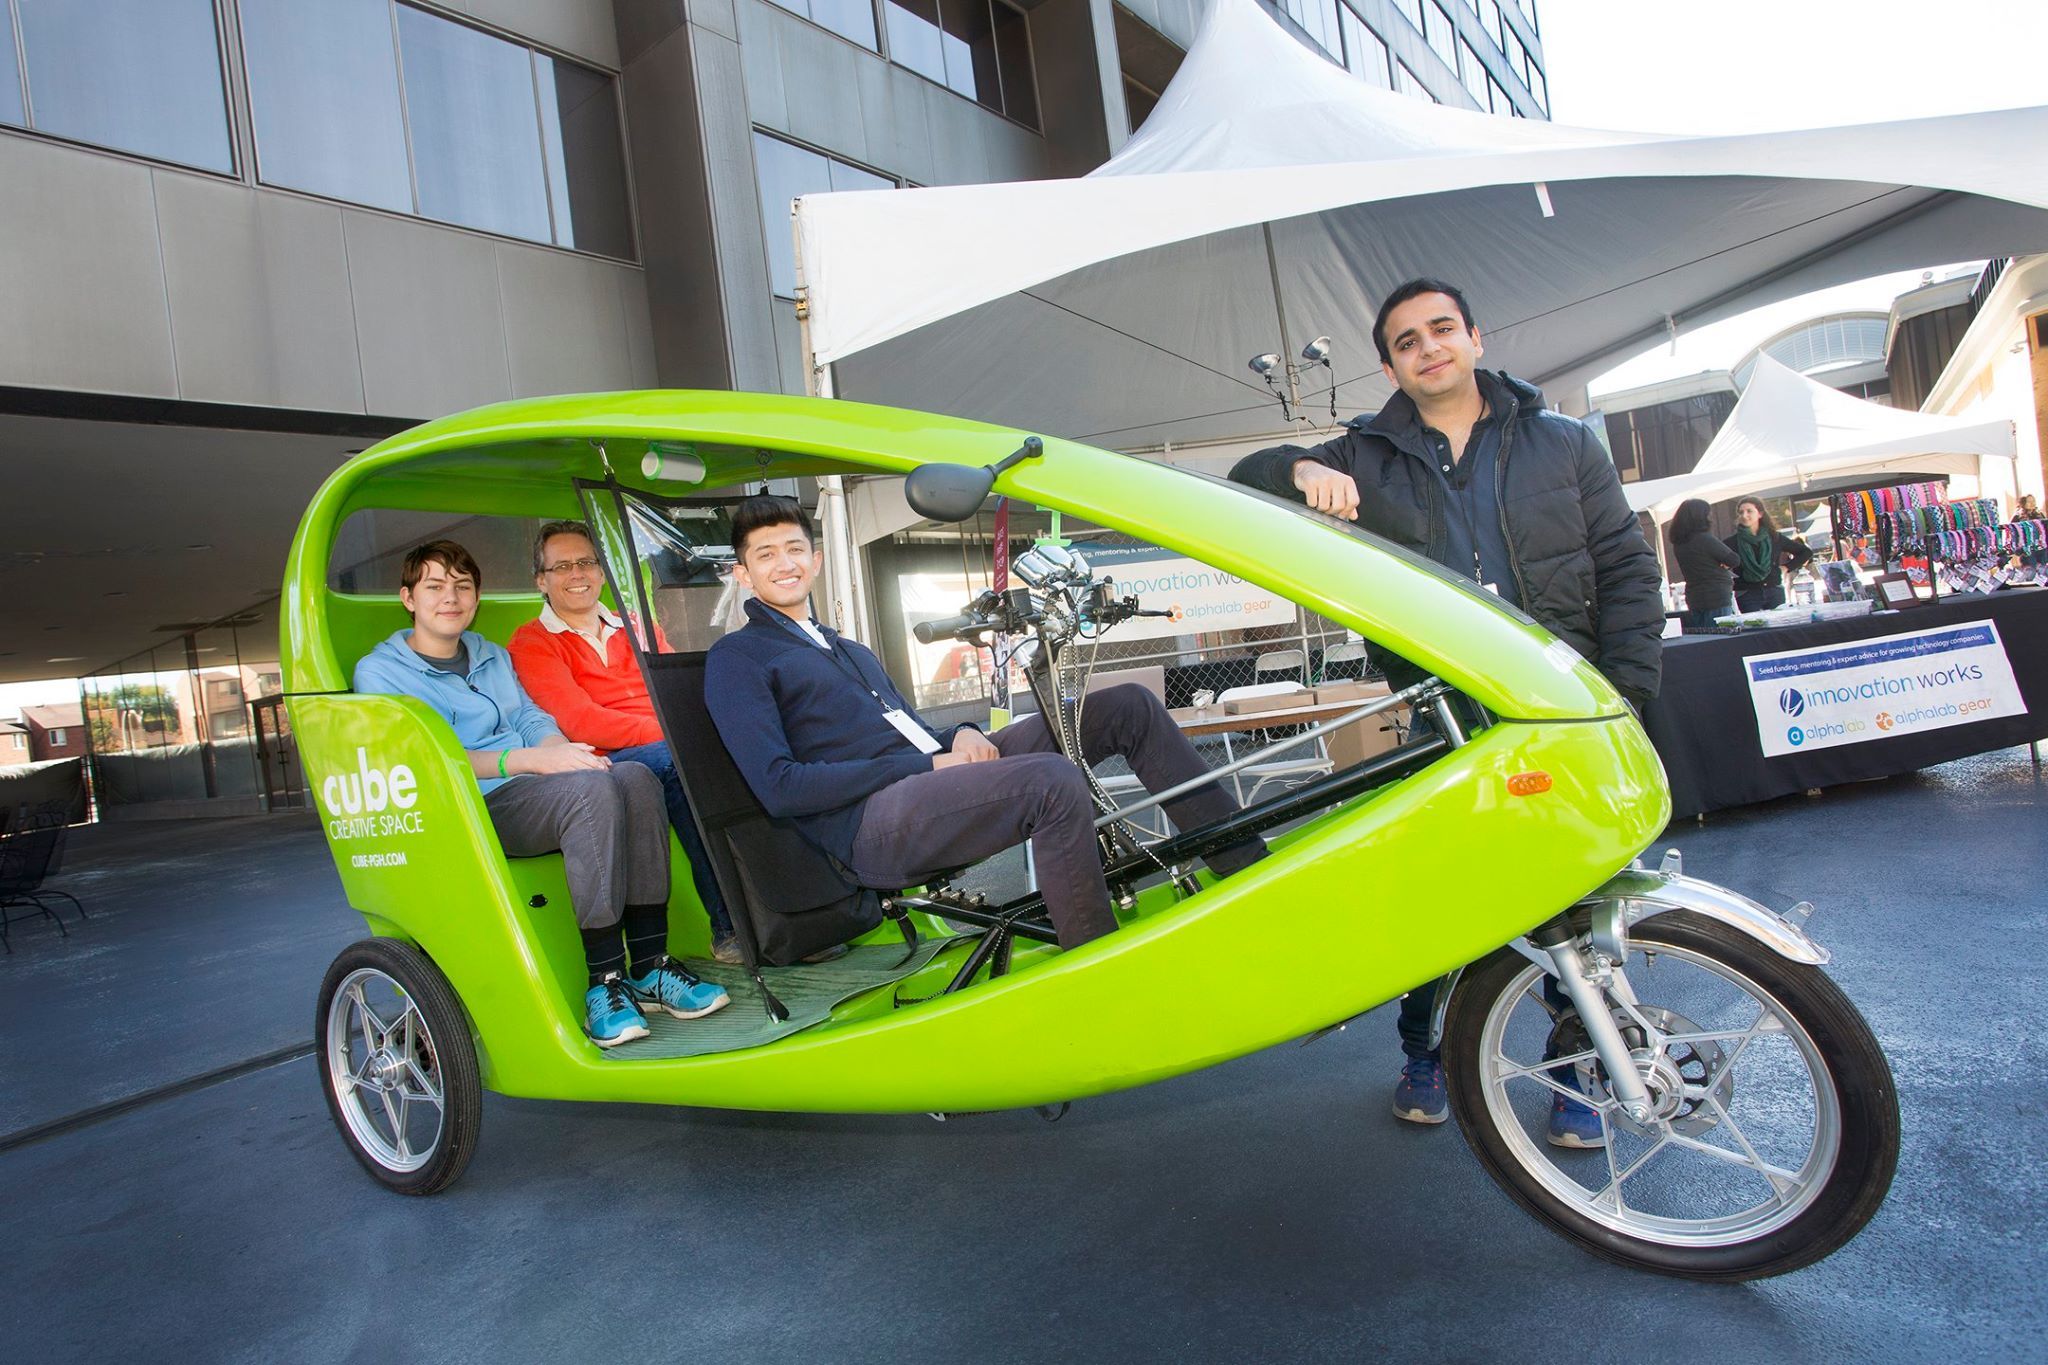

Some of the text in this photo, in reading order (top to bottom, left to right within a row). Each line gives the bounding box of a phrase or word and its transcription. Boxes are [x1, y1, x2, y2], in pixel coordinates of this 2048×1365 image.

[1095, 548, 1130, 557] mentoring
[1185, 599, 1272, 618] alphalab gear
[1759, 667, 1774, 675] Seed
[1774, 664, 1799, 673] funding,
[1800, 659, 1832, 669] mentoring
[1837, 654, 1858, 665] expert
[1858, 651, 1879, 660] advice
[1879, 649, 1888, 657] for
[1889, 645, 1916, 656] growing
[1916, 639, 1950, 651] technology
[1950, 633, 1984, 645] companies
[1806, 663, 1983, 707] innovation works
[1806, 717, 1865, 739] alphalab
[1895, 703, 1957, 726] alphalab
[1958, 698, 1992, 715] gear
[324, 747, 418, 816] cube
[329, 811, 424, 839] CREATIVE SPACE
[352, 853, 407, 868] CUBE-PGH.COM
